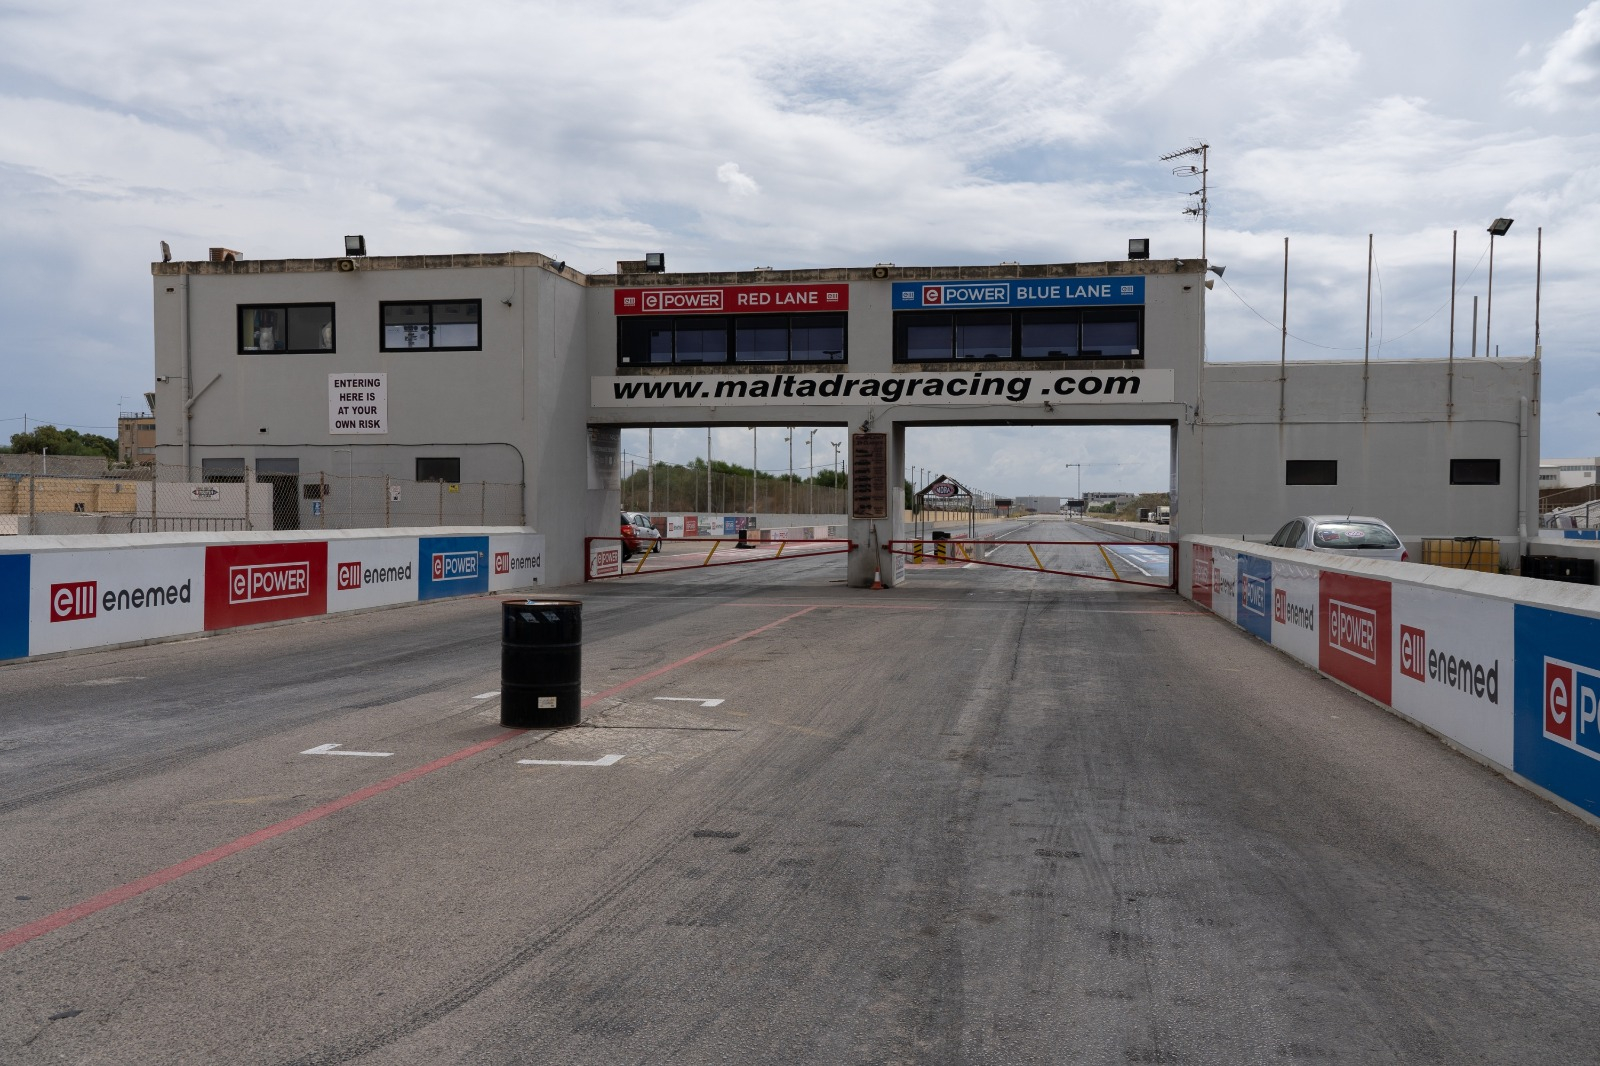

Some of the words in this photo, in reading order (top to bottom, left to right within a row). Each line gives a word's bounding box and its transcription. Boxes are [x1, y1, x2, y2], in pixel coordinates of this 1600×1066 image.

[737, 292, 771, 306] RED
[775, 291, 819, 305] LANE
[1017, 286, 1061, 300] BLUE
[1065, 284, 1112, 298] LANE
[334, 378, 381, 388] ENTERING
[339, 392, 364, 402] HERE
[366, 392, 376, 401] IS
[338, 406, 350, 415] AT
[351, 405, 378, 415] YOUR
[335, 420, 356, 429] OWN
[358, 419, 381, 429] RISK
[510, 552, 541, 570] enemed
[363, 561, 412, 585] enemed
[102, 578, 191, 611] enemed
[1287, 602, 1314, 632] enemed
[1428, 648, 1499, 705] enemed
